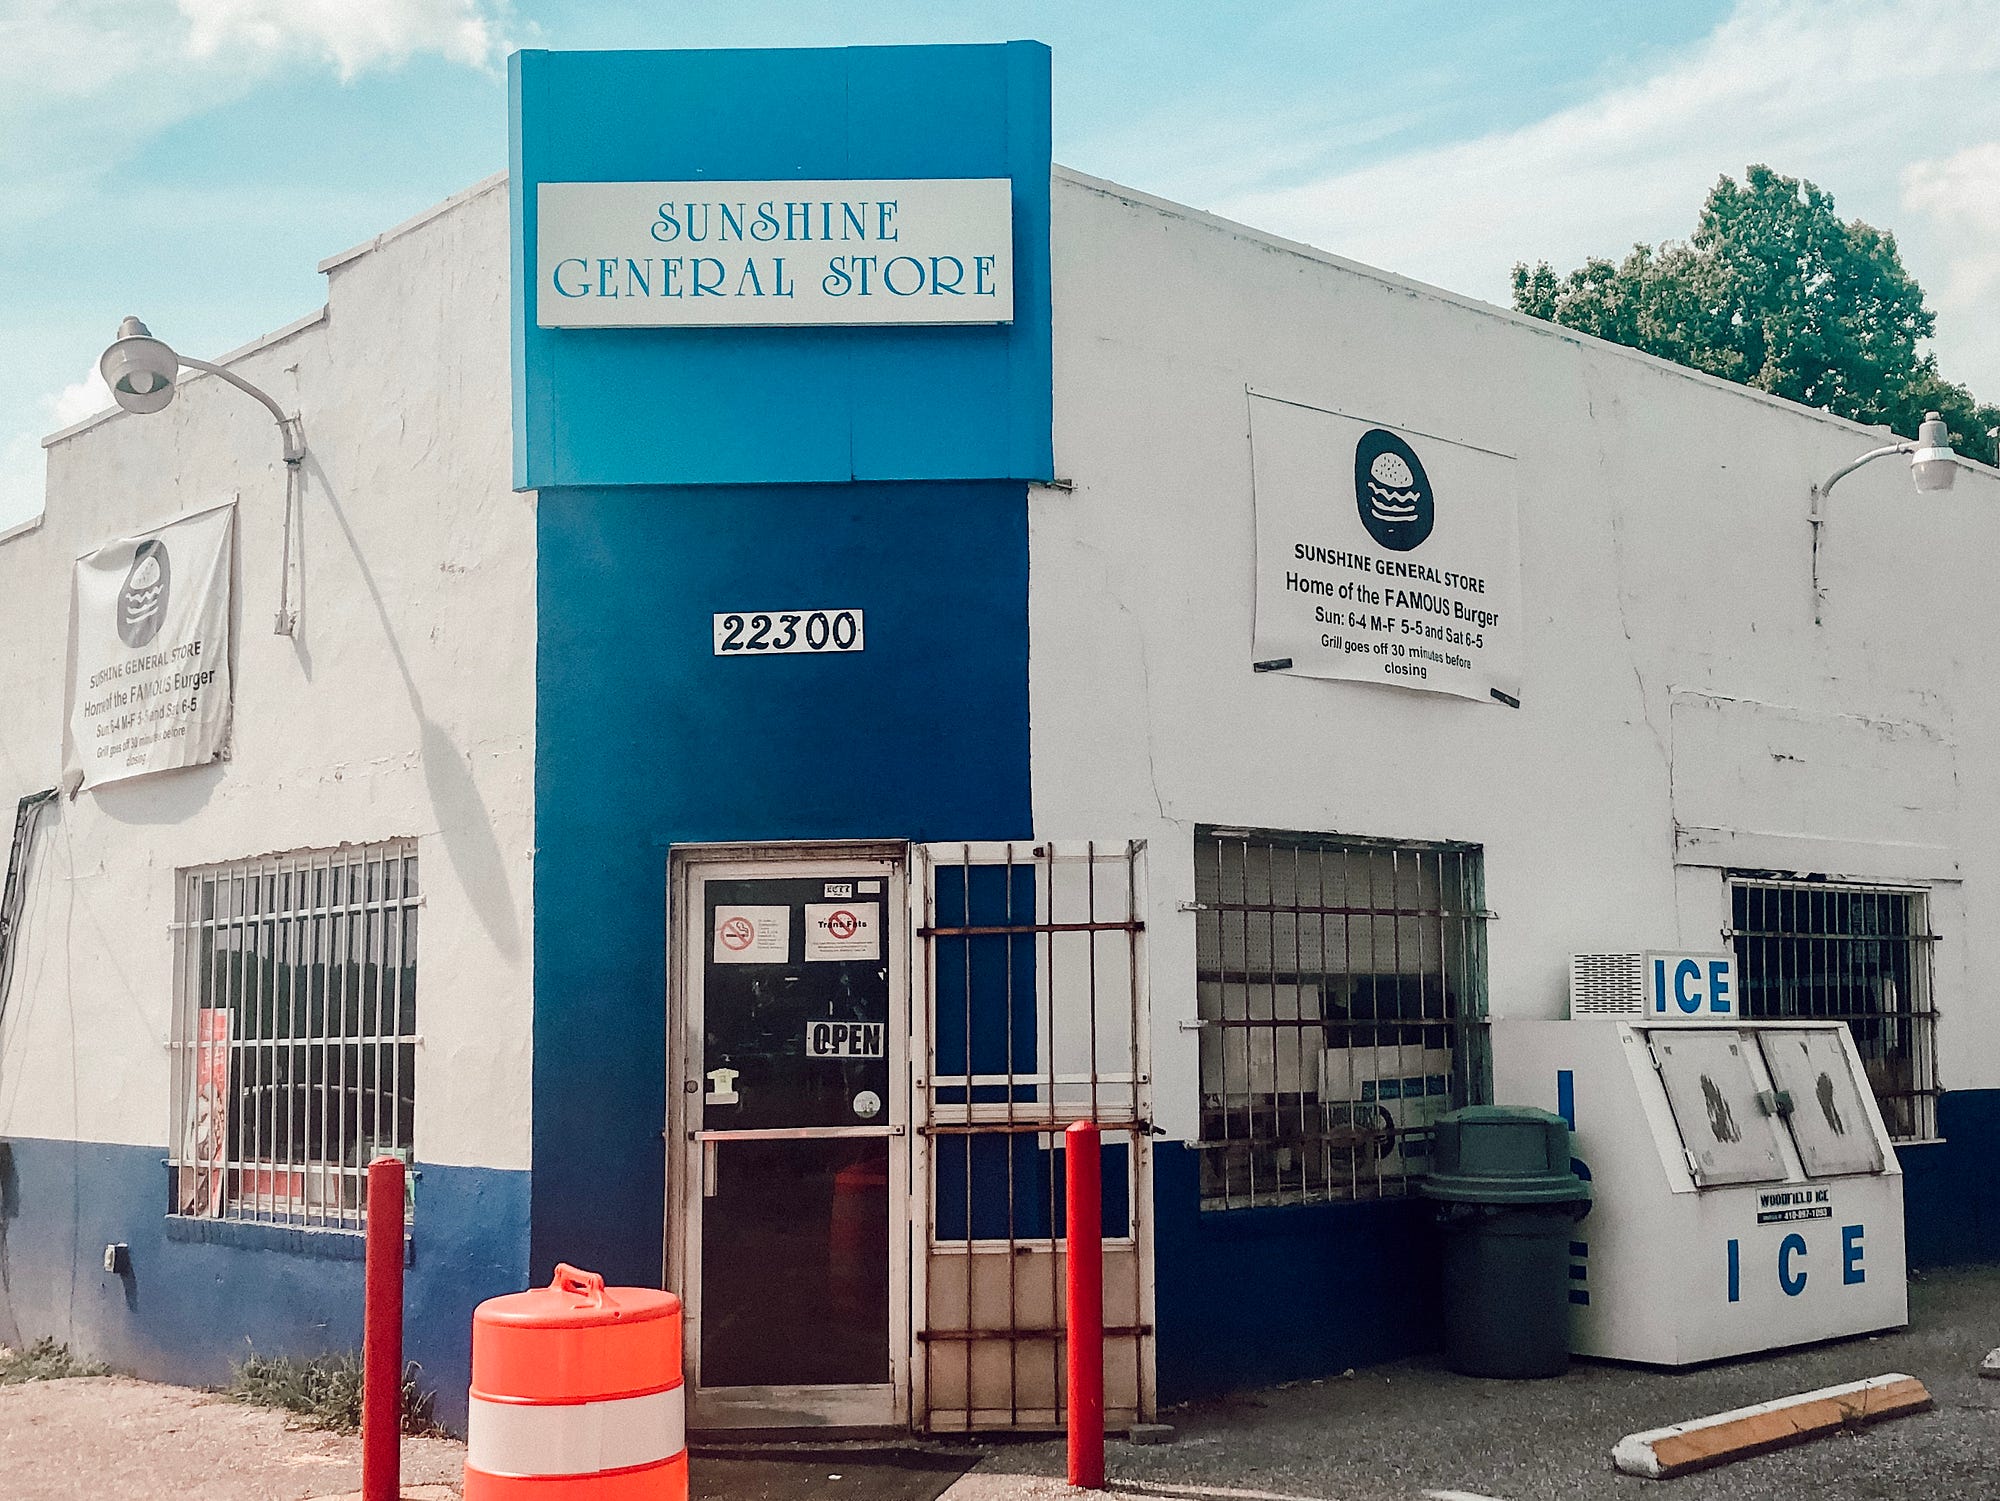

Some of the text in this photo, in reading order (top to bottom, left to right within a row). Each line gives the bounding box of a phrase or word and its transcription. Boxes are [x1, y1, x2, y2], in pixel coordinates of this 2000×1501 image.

[651, 200, 898, 243] SUNSHINE
[553, 254, 996, 299] GENERAL STORE
[1294, 543, 1485, 594] SUNSHINE GENERAL STORE
[1286, 571, 1499, 629] Home of the FAMOUS Burger
[721, 611, 857, 651] 22300
[1315, 606, 1483, 649] Sun: 6-4 M-F 5-5 and Sat 6-5
[89, 640, 202, 689] SUSHINE GENERAL STORE
[1321, 633, 1472, 670] Grill goes off 30 minutes before
[1384, 661, 1427, 680] closing
[114, 690, 128, 708] the
[174, 670, 215, 691] Burger
[121, 712, 136, 730] M-F
[181, 696, 197, 713] 6-5
[1654, 958, 1732, 1014] ICE
[813, 1023, 881, 1055] OPEN
[1760, 1189, 1829, 1207] WOODFIELD ICE
[1726, 1224, 1867, 1303] ICE
